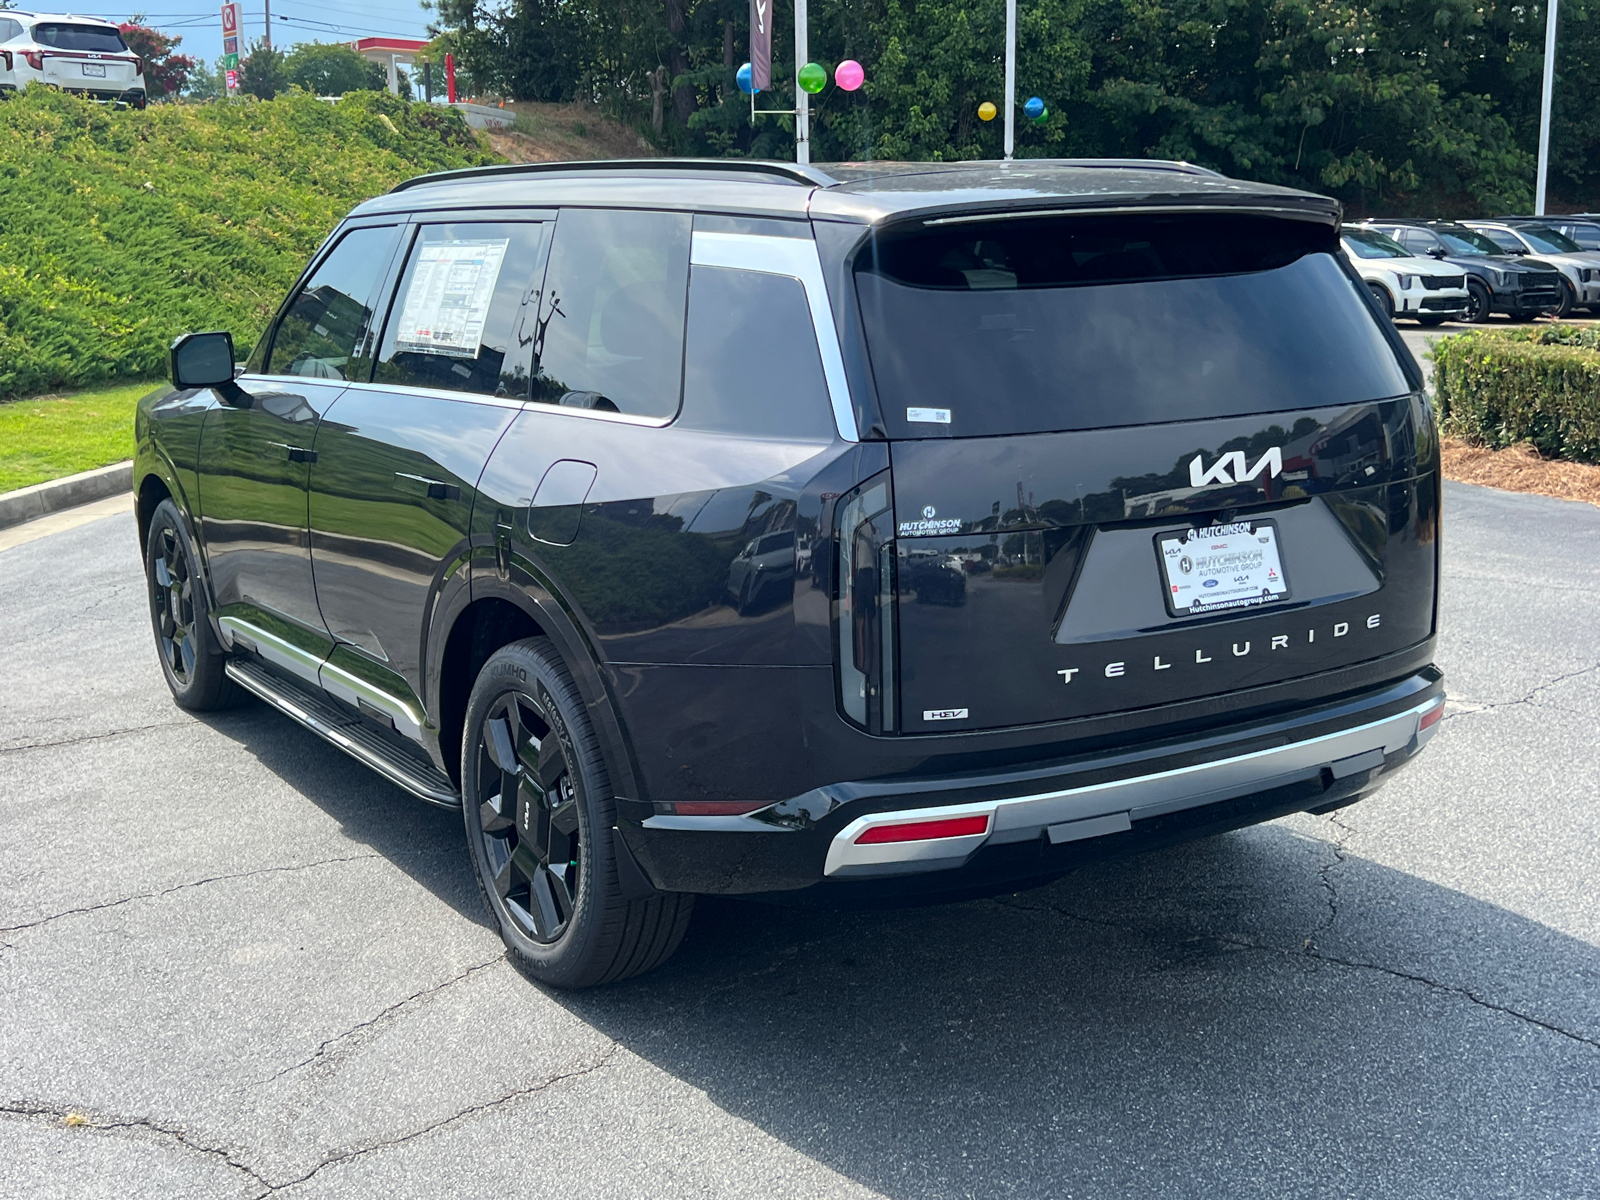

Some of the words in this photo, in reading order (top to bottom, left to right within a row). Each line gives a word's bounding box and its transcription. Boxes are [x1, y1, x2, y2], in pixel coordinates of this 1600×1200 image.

[1189, 446, 1282, 487] KIA
[899, 519, 961, 531] HUTCHINSON
[900, 529, 938, 537] AUTOMOTIVE
[1199, 522, 1251, 539] HUTCHINSON
[1165, 547, 1181, 555] KIA
[1196, 549, 1263, 570] HUTCHINSON
[1199, 565, 1239, 577] AUTOMOTIVE
[1240, 561, 1263, 571] GROUP
[1198, 585, 1259, 599] HUTCHINSONAUTOGROUP.COM
[1189, 594, 1279, 614] Hutchinsonautogroup.com
[1057, 614, 1381, 684] TELLURIDE
[491, 663, 527, 681] KUMHO
[932, 710, 963, 718] HEV
